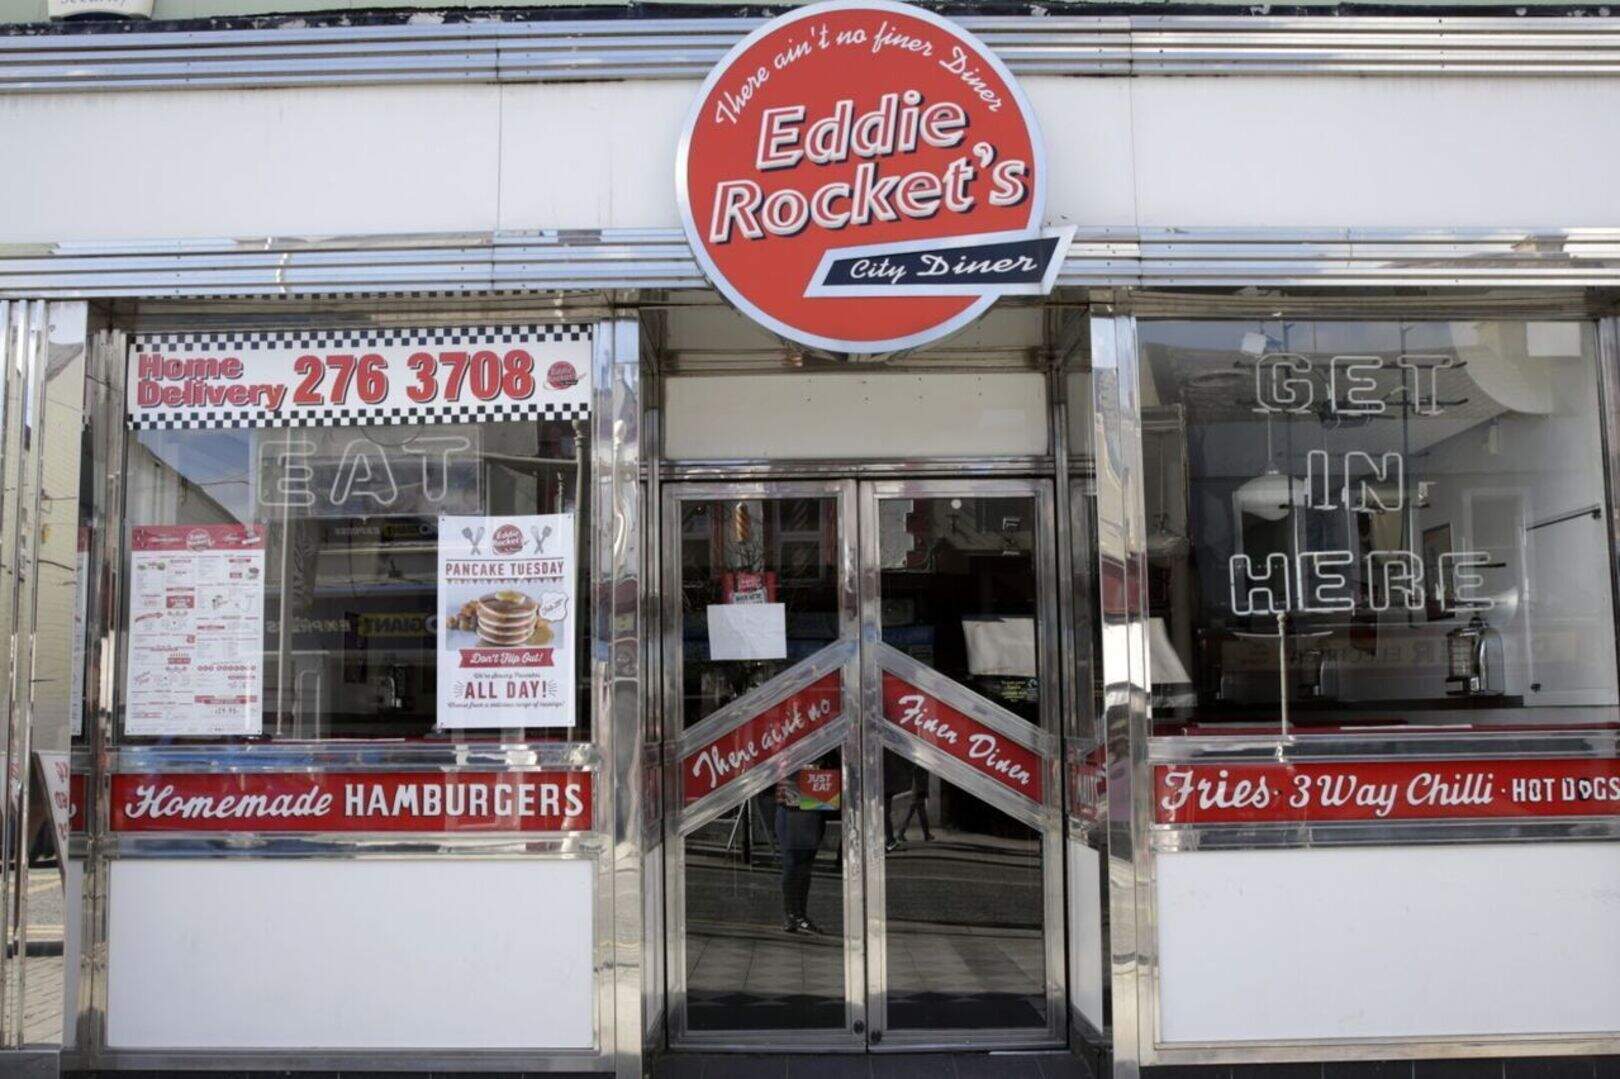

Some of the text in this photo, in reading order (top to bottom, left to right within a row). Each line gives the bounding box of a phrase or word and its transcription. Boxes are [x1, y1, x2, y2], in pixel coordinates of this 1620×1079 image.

[716, 21, 1004, 124] There ain't no finer Diner
[755, 90, 968, 170] Eddie
[709, 141, 1027, 243] Rocket's
[851, 253, 1038, 284] City Diner
[138, 354, 243, 380] Home
[293, 353, 388, 405] 276
[406, 349, 535, 402] 3708
[1256, 353, 1452, 414] GET
[137, 379, 287, 412] Delivery
[259, 437, 471, 506] EAT
[1306, 450, 1405, 513] IN
[446, 561, 564, 576] PANCAKE TUESDAY
[1229, 550, 1495, 616] HERE
[470, 652, 499, 664] Don't
[465, 680, 547, 699] ALL DAY!
[692, 741, 758, 788] There
[808, 699, 831, 721] no
[899, 695, 1030, 784] Finer Diner
[125, 783, 584, 819] Homemade HAMBURGERS
[807, 774, 832, 784] JUST
[813, 783, 832, 792] EAT
[1290, 775, 1312, 808] 3
[1317, 775, 1398, 817] Way
[1406, 772, 1494, 806] Chilli
[1512, 778, 1555, 802] HOT
[1562, 777, 1620, 801] DOGS
